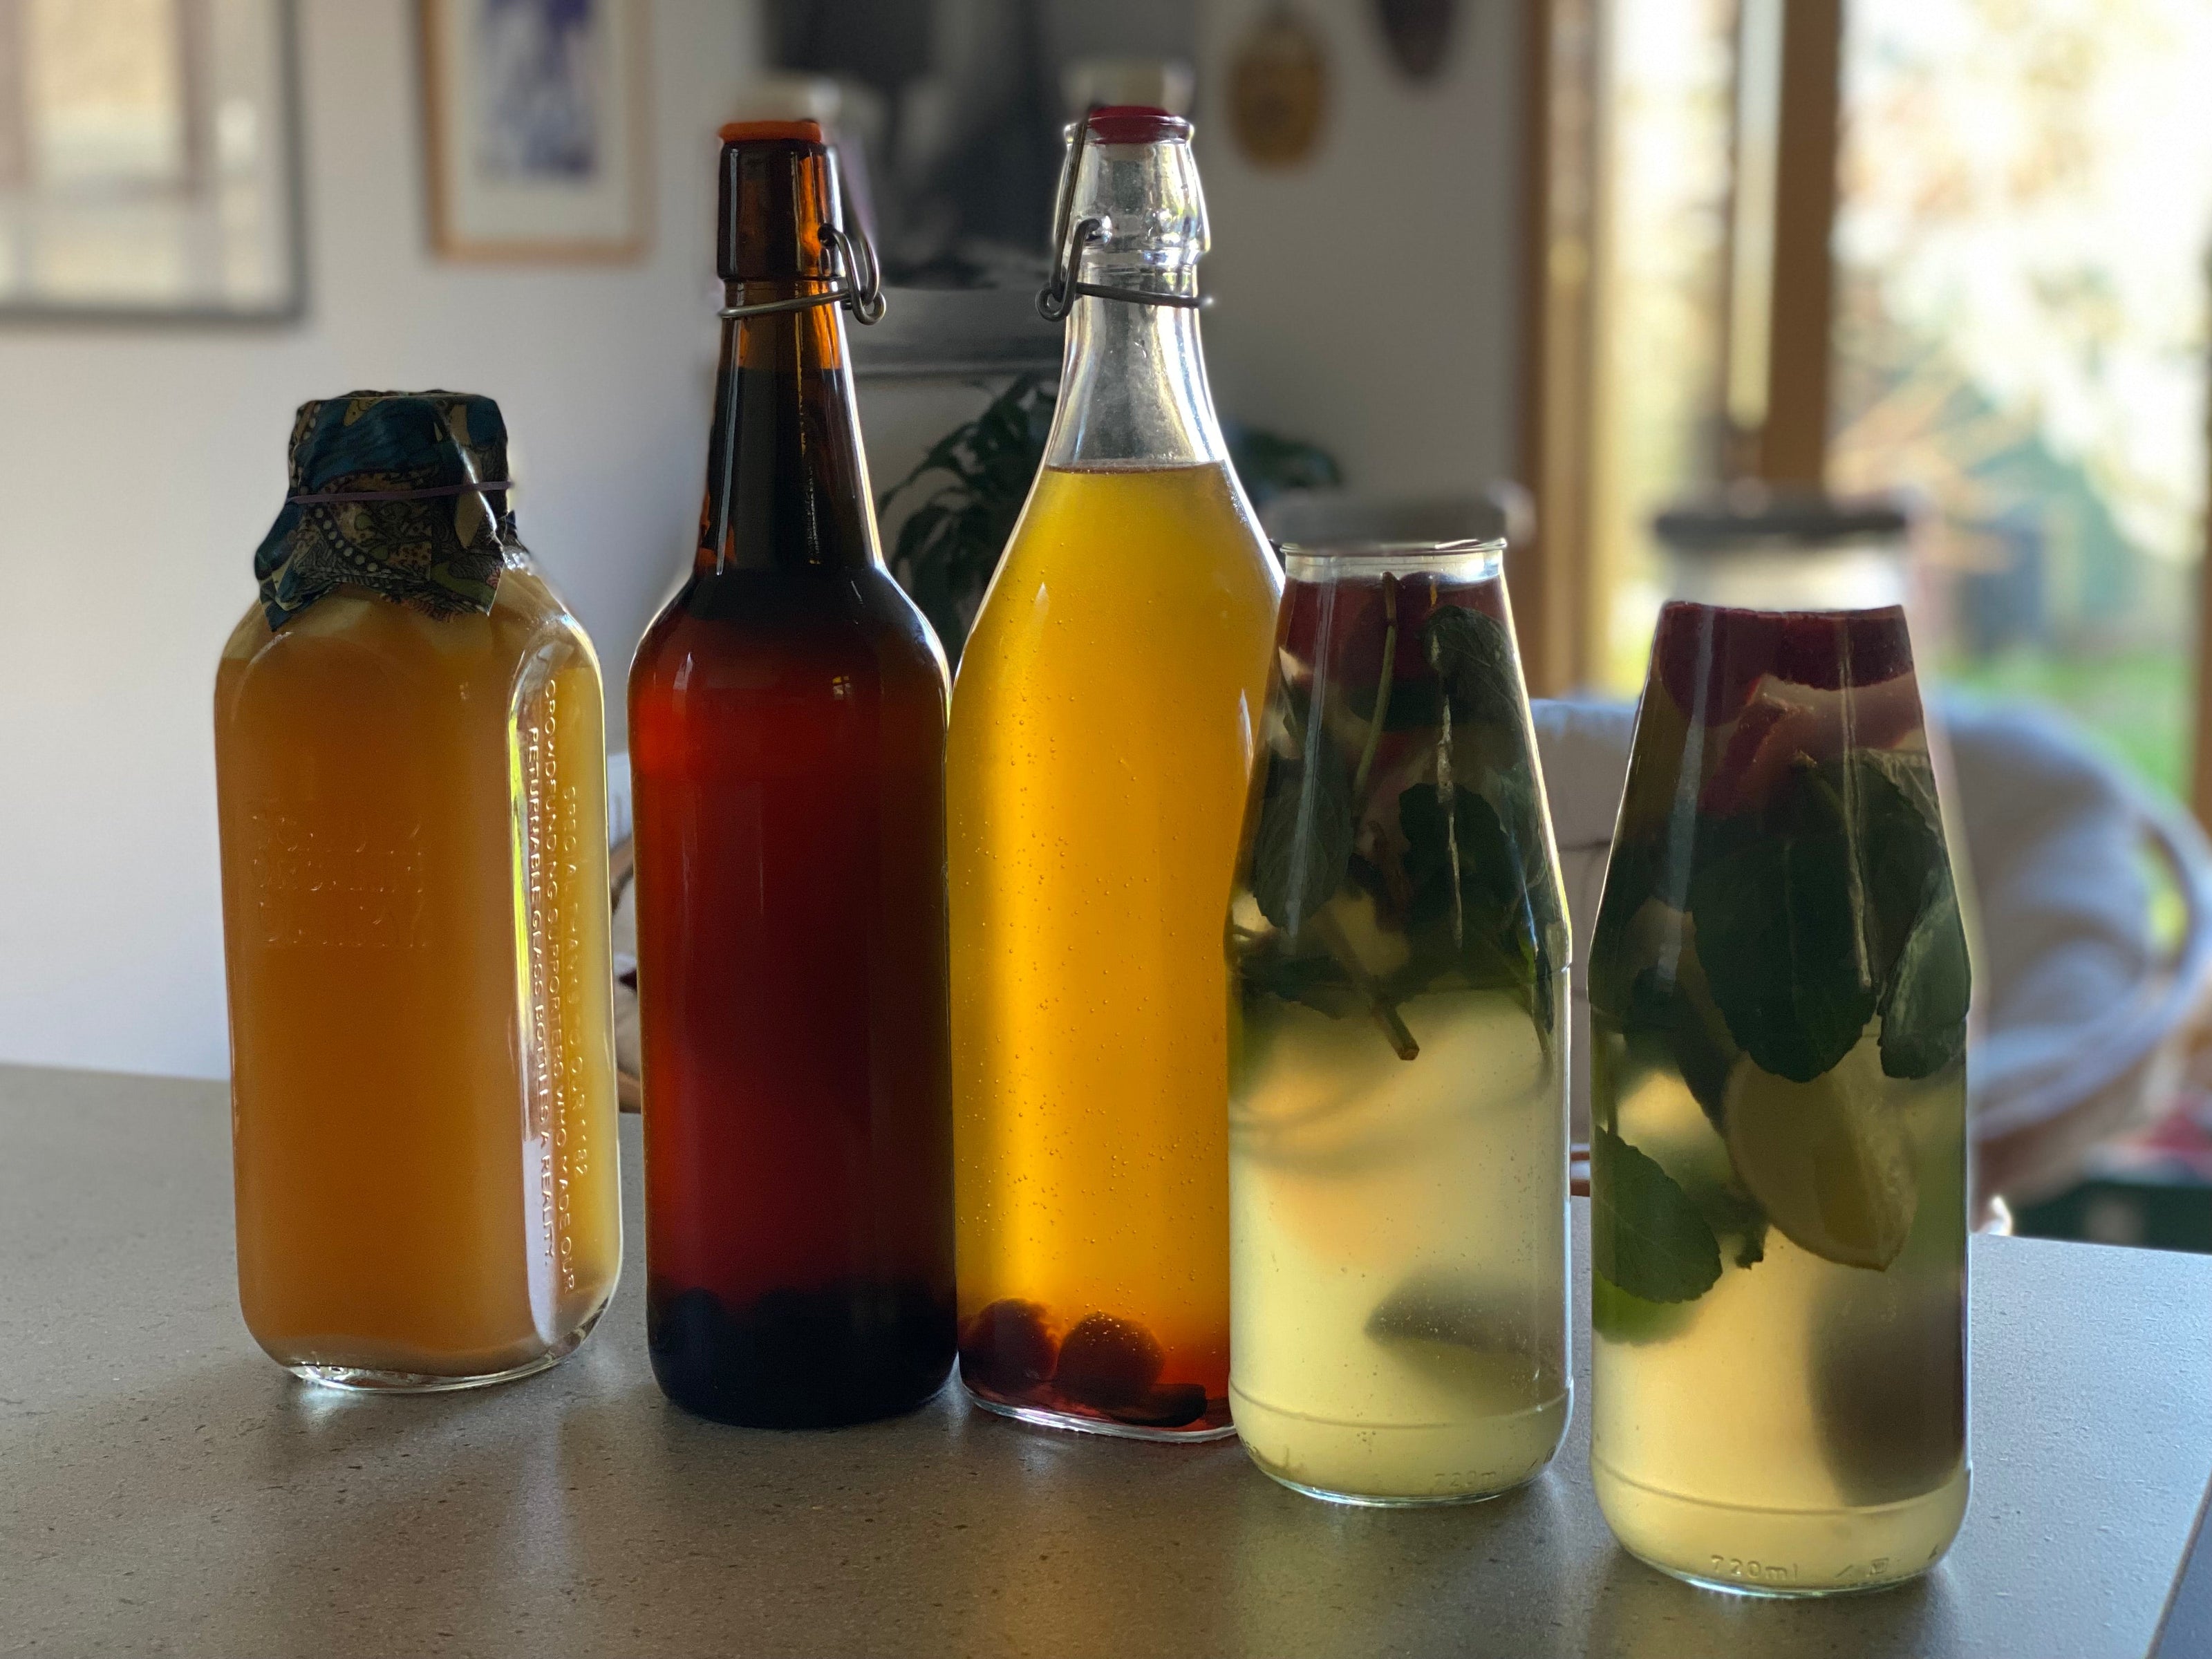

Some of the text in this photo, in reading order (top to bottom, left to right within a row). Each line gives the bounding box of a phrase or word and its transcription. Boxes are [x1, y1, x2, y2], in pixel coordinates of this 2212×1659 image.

[528, 727, 541, 903] RETURNABLE
[532, 910, 543, 996] GLASS
[544, 679, 574, 1295] CROWDFUNDING SUPPORTERS WHO MADE OUR
[534, 1004, 549, 1124] BOTTLES
[570, 1056, 585, 1111] OUR
[540, 1130, 550, 1150] A
[1711, 1554, 1798, 1582] 720ml
